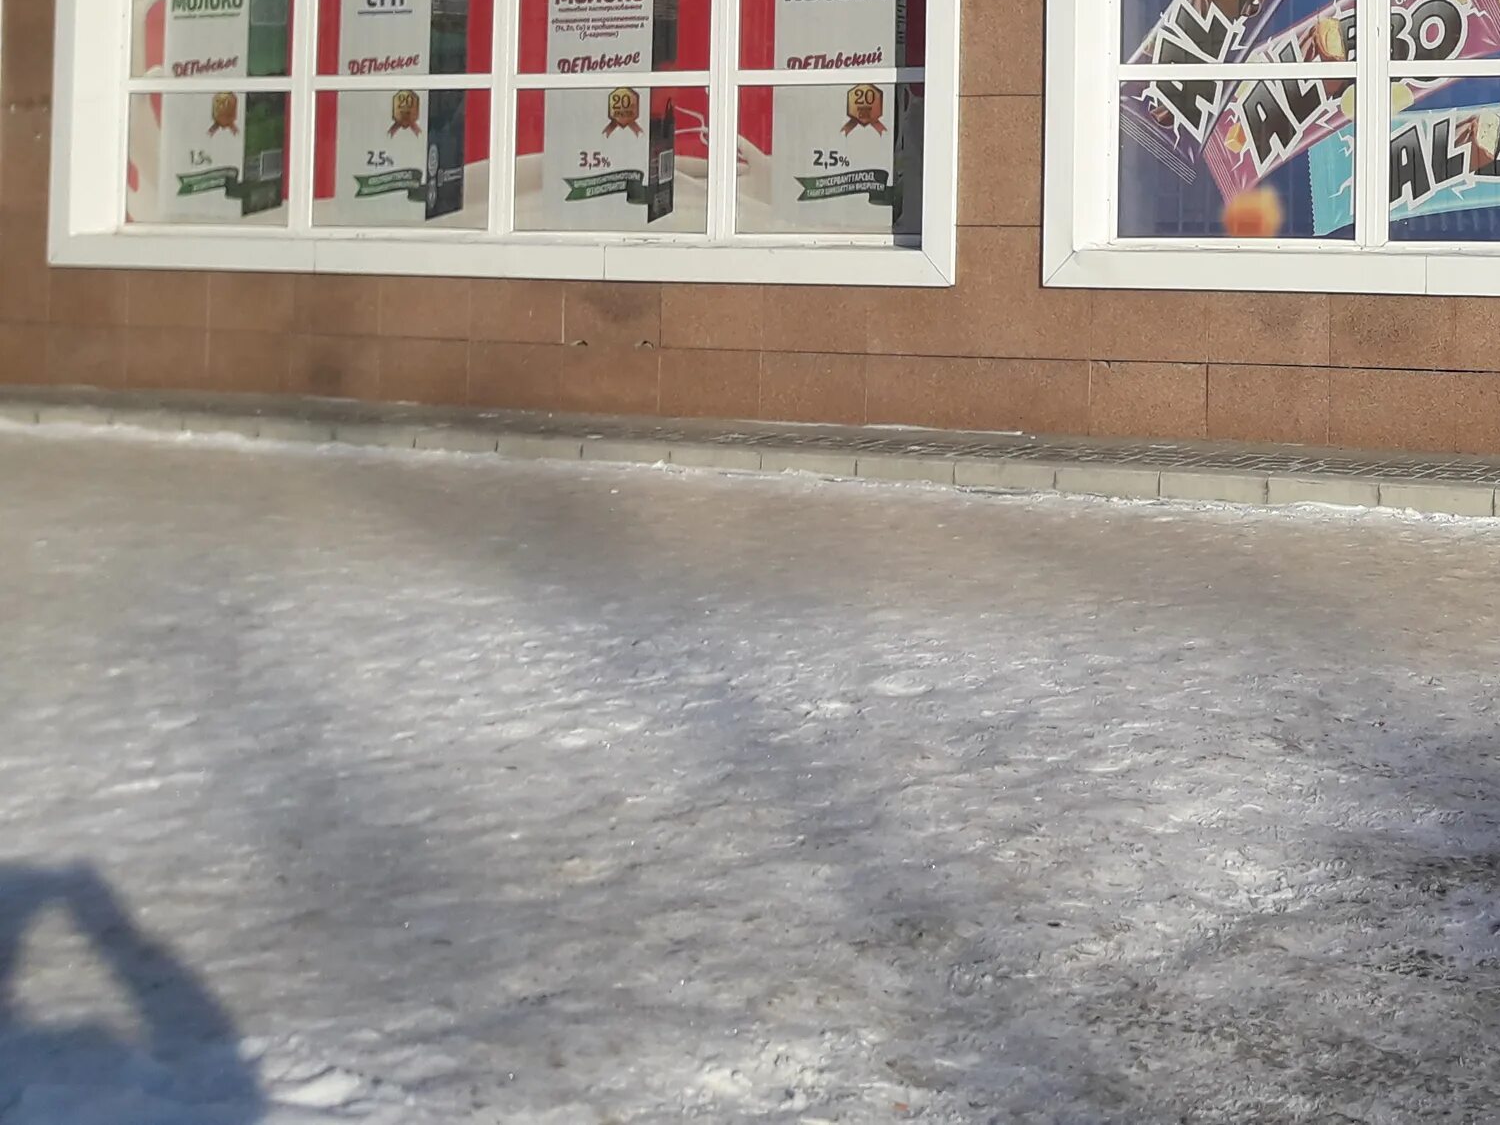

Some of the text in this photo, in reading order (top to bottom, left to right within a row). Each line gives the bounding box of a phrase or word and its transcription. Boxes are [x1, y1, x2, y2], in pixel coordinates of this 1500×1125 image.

[611, 94, 631, 110] 20
[853, 89, 875, 105] 20
[366, 150, 394, 167] 2,5%
[579, 151, 611, 170] 3,5%
[813, 150, 850, 170] 2,5%
